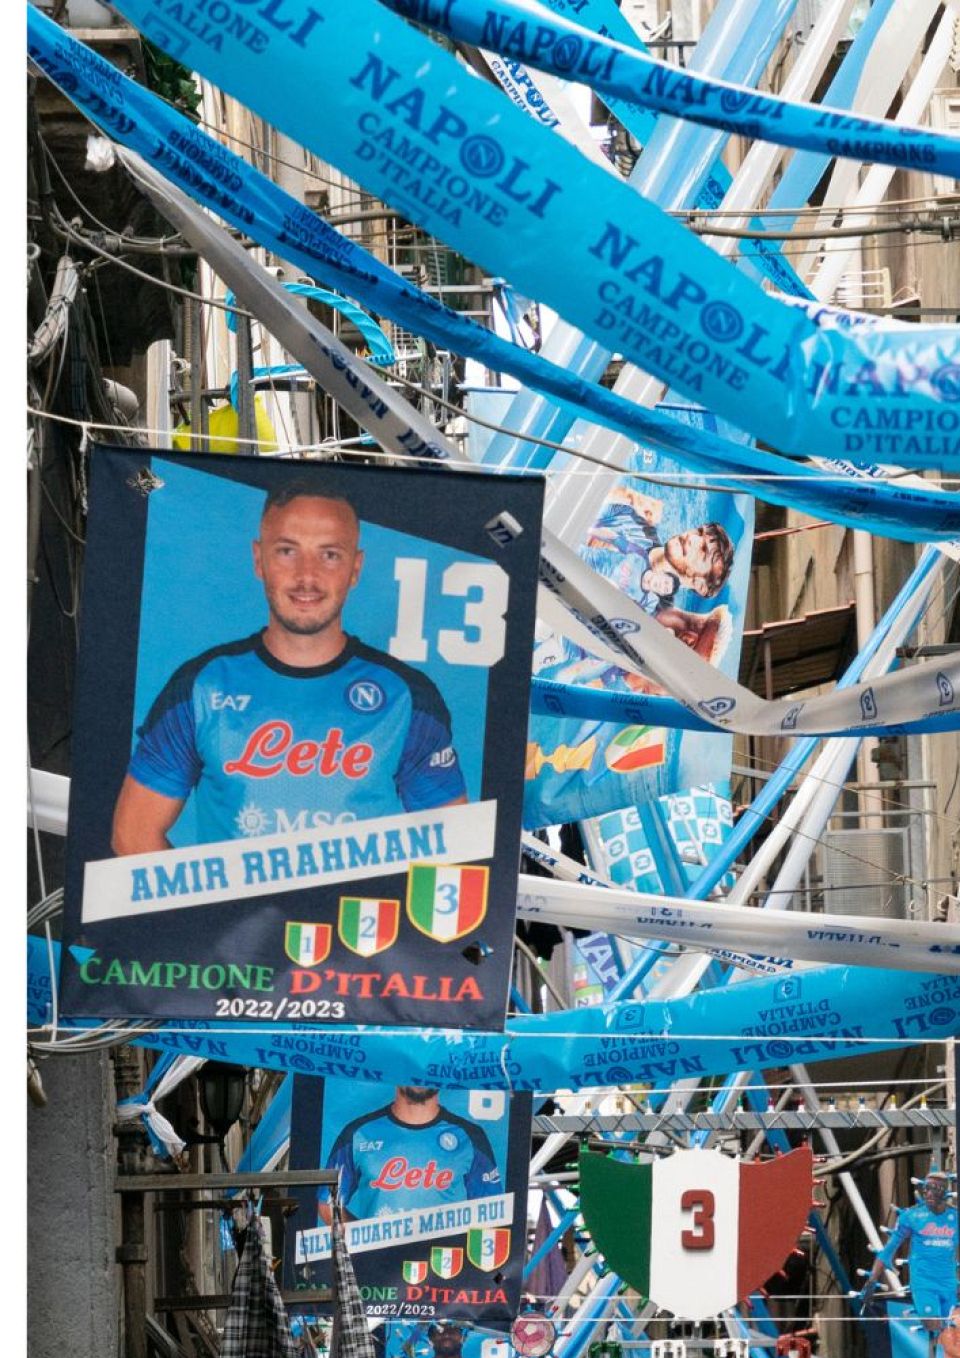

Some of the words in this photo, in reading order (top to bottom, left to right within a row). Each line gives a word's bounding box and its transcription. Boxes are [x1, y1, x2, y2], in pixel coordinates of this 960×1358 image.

[480, 10, 623, 81] NAPOLI
[503, 56, 562, 129] APOLI
[641, 62, 787, 119] NAPOLI
[350, 52, 562, 219] NAPOLI
[353, 139, 465, 230] D'ITALIA
[358, 112, 510, 228] CAMPIONE
[588, 220, 792, 382] NAPOLI
[593, 308, 706, 393] D'ITALIA
[597, 281, 750, 391] CAMPIONE
[387, 556, 511, 668] 13
[209, 692, 251, 712] EA7
[223, 720, 375, 780] Lete
[273, 807, 358, 836] MSC
[130, 865, 229, 903] AMIR
[242, 822, 449, 883] RRAHMANI
[435, 882, 459, 915] 3
[303, 936, 313, 954] 1
[360, 914, 377, 939] 2
[79, 956, 276, 993] CAMPIONE
[289, 969, 485, 1002] D'ITALIA
[215, 997, 347, 1020] 2022/2023
[141, 1031, 229, 1058] NAPO
[728, 1024, 865, 1065] NAPOLI
[569, 1054, 707, 1088] NAPOLI
[370, 1156, 455, 1191] Lete
[300, 1228, 332, 1257] SILV
[350, 1218, 414, 1248] DUARTE
[476, 1198, 506, 1223] RUI
[680, 1188, 716, 1251] 3
[481, 1237, 496, 1258] 3
[366, 1302, 437, 1317] 2022/2023
[406, 1285, 509, 1305] D'ITALIA
